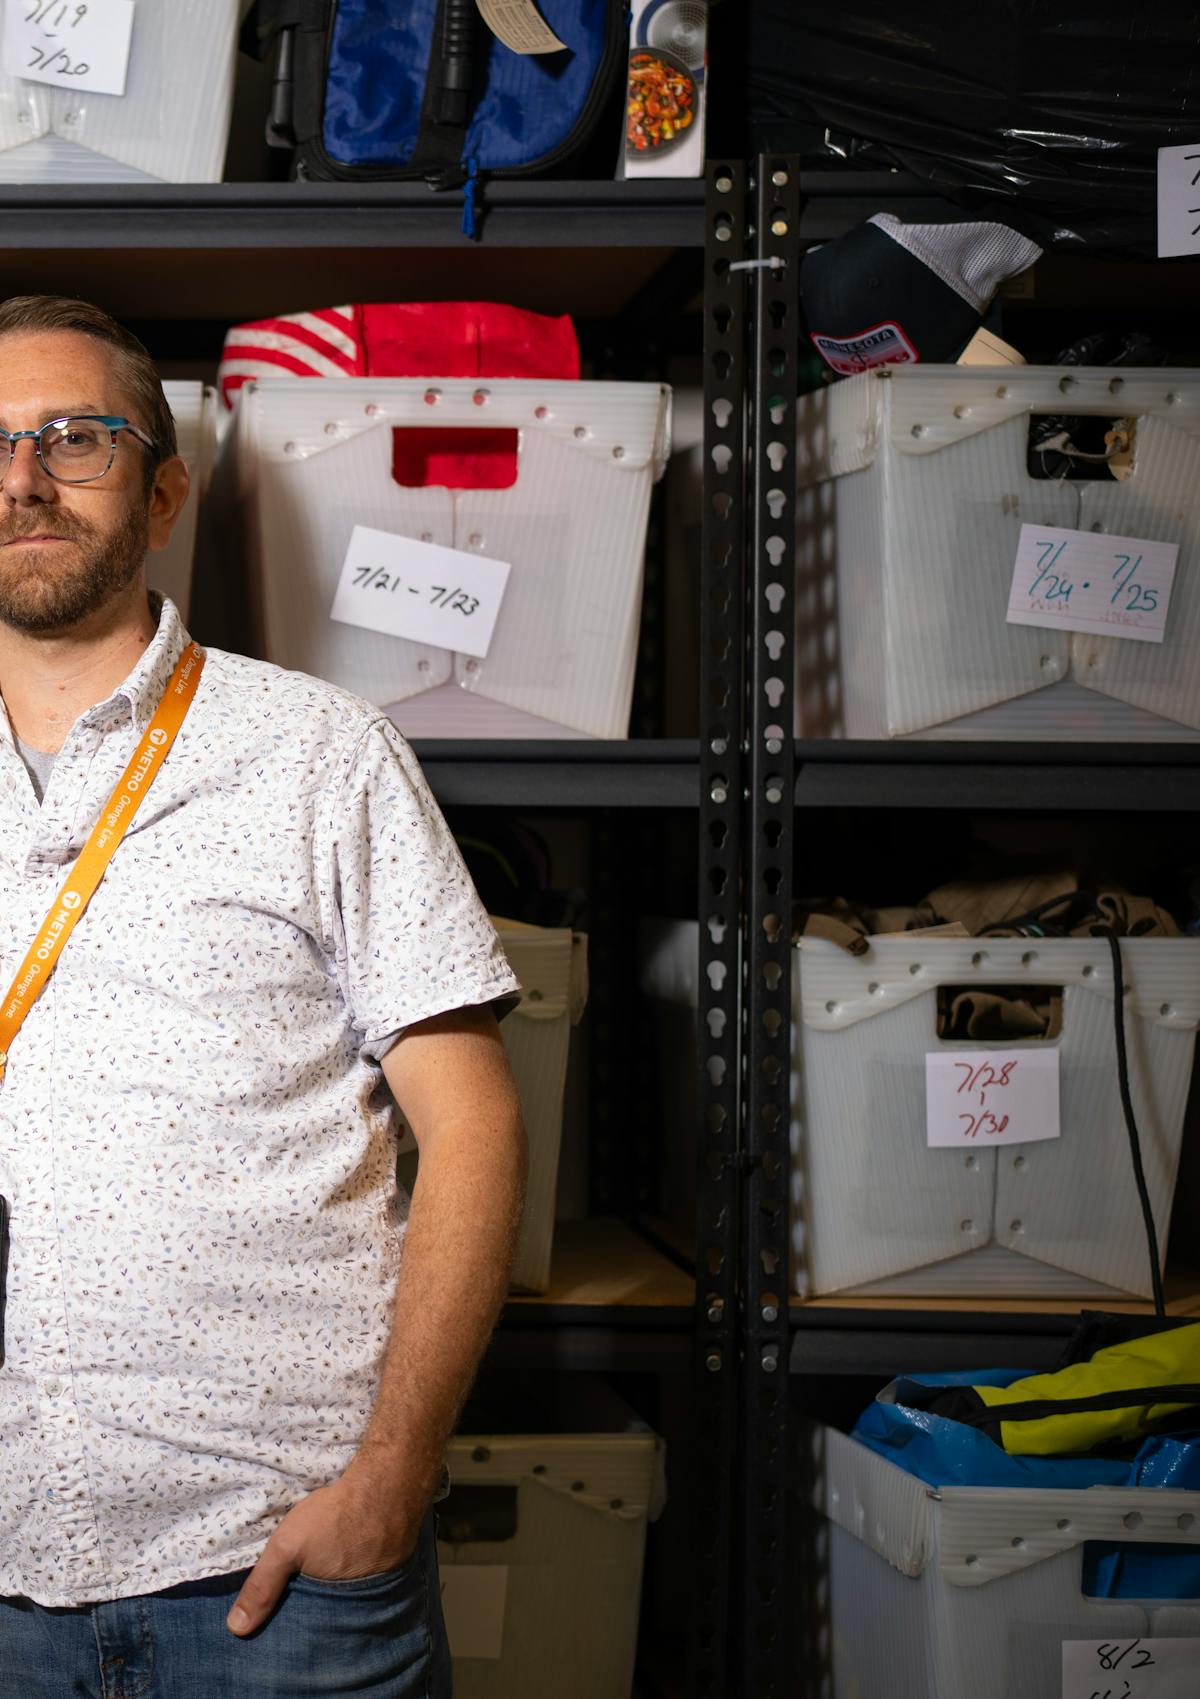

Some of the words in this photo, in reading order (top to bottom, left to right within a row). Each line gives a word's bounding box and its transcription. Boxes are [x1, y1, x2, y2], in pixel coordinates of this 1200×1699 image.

[24, 0, 88, 28] 7/19
[26, 46, 91, 76] 7/20
[352, 566, 400, 593] 7/21
[430, 586, 480, 617] 7/23
[1028, 541, 1074, 602] 7/24
[1111, 555, 1159, 612] 7/25
[127, 745, 158, 792] METRO
[106, 795, 131, 828] Orange
[96, 827, 114, 849] Line
[37, 908, 71, 960] METRO
[16, 963, 41, 998] Orange
[5, 998, 22, 1019] Line
[954, 1060, 1018, 1093] 7/28
[958, 1109, 1010, 1138] 7/30
[1097, 1639, 1155, 1671] 8/2
